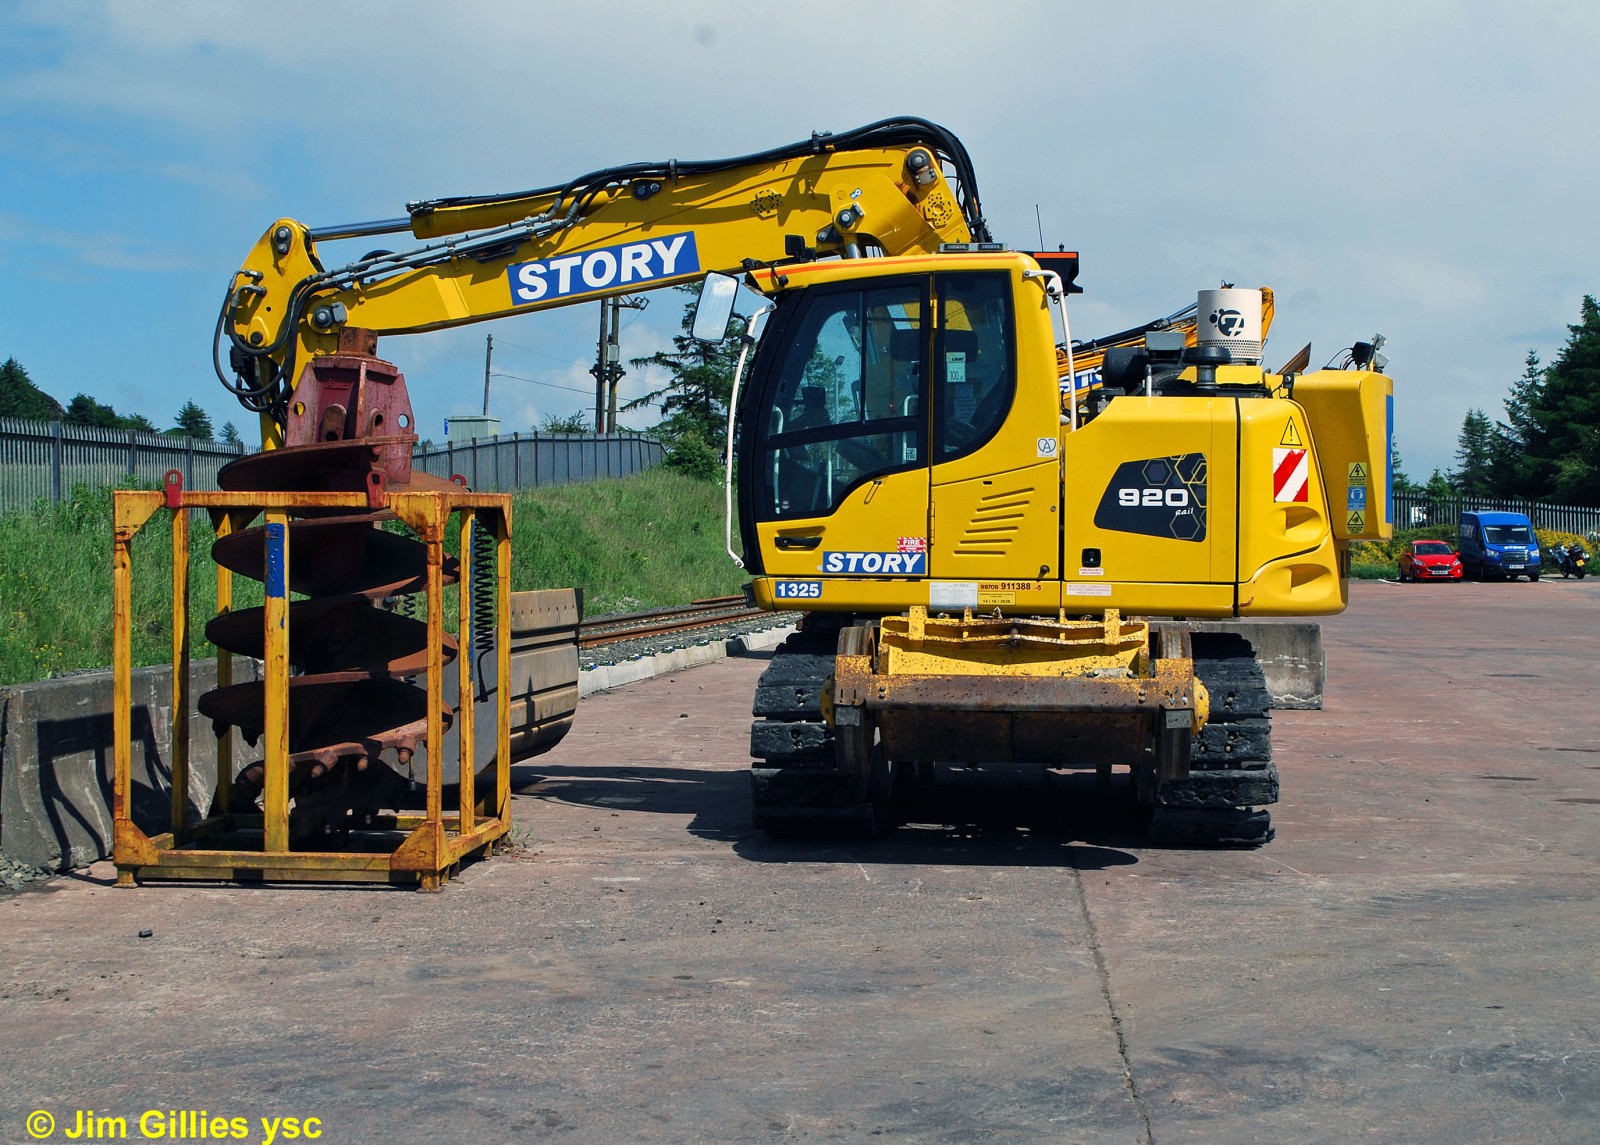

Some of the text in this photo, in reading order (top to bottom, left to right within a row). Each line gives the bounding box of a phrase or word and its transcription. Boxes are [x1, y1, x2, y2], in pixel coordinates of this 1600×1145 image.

[517, 236, 688, 300] STORY
[1118, 488, 1189, 507] 920
[826, 553, 922, 573] STORY
[778, 583, 820, 597] 1325
[1001, 582, 1031, 591] 911388
